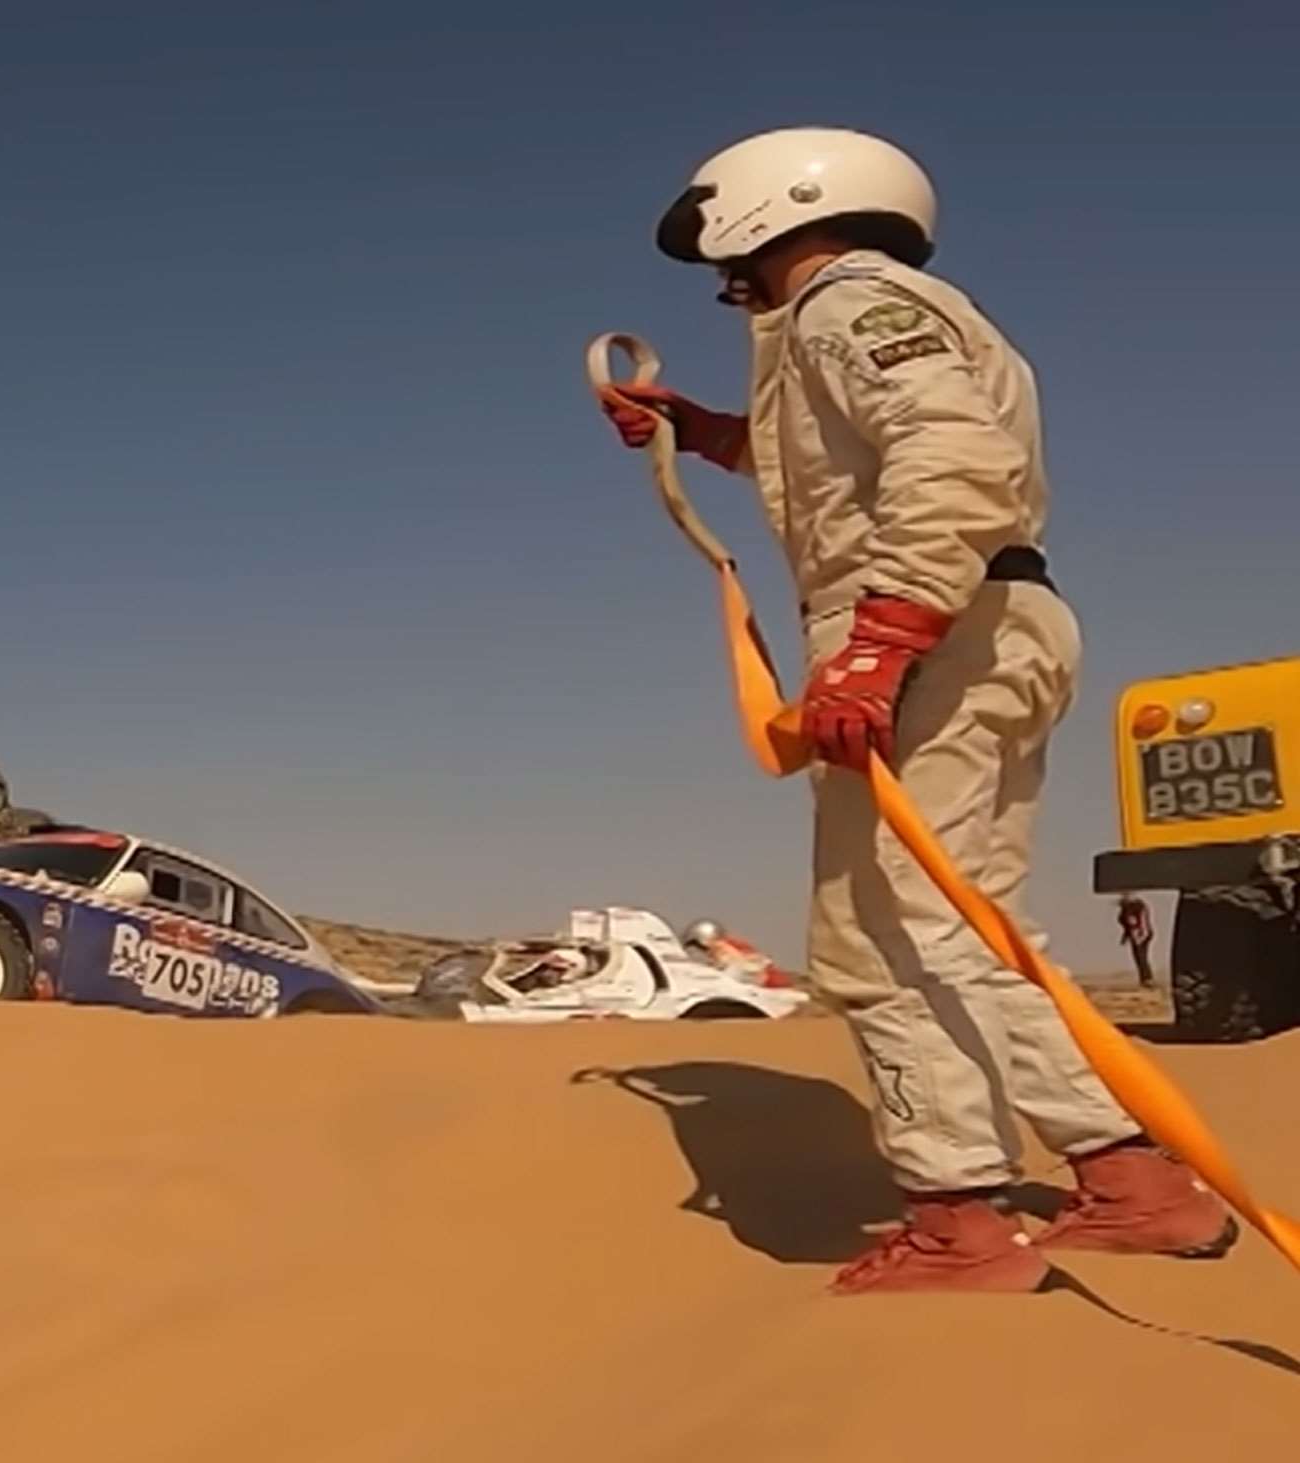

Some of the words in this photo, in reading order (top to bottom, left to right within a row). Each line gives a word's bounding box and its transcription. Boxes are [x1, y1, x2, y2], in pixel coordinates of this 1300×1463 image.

[1158, 734, 1254, 778] BOW
[1149, 770, 1276, 817] 835C
[150, 953, 205, 997] 705
